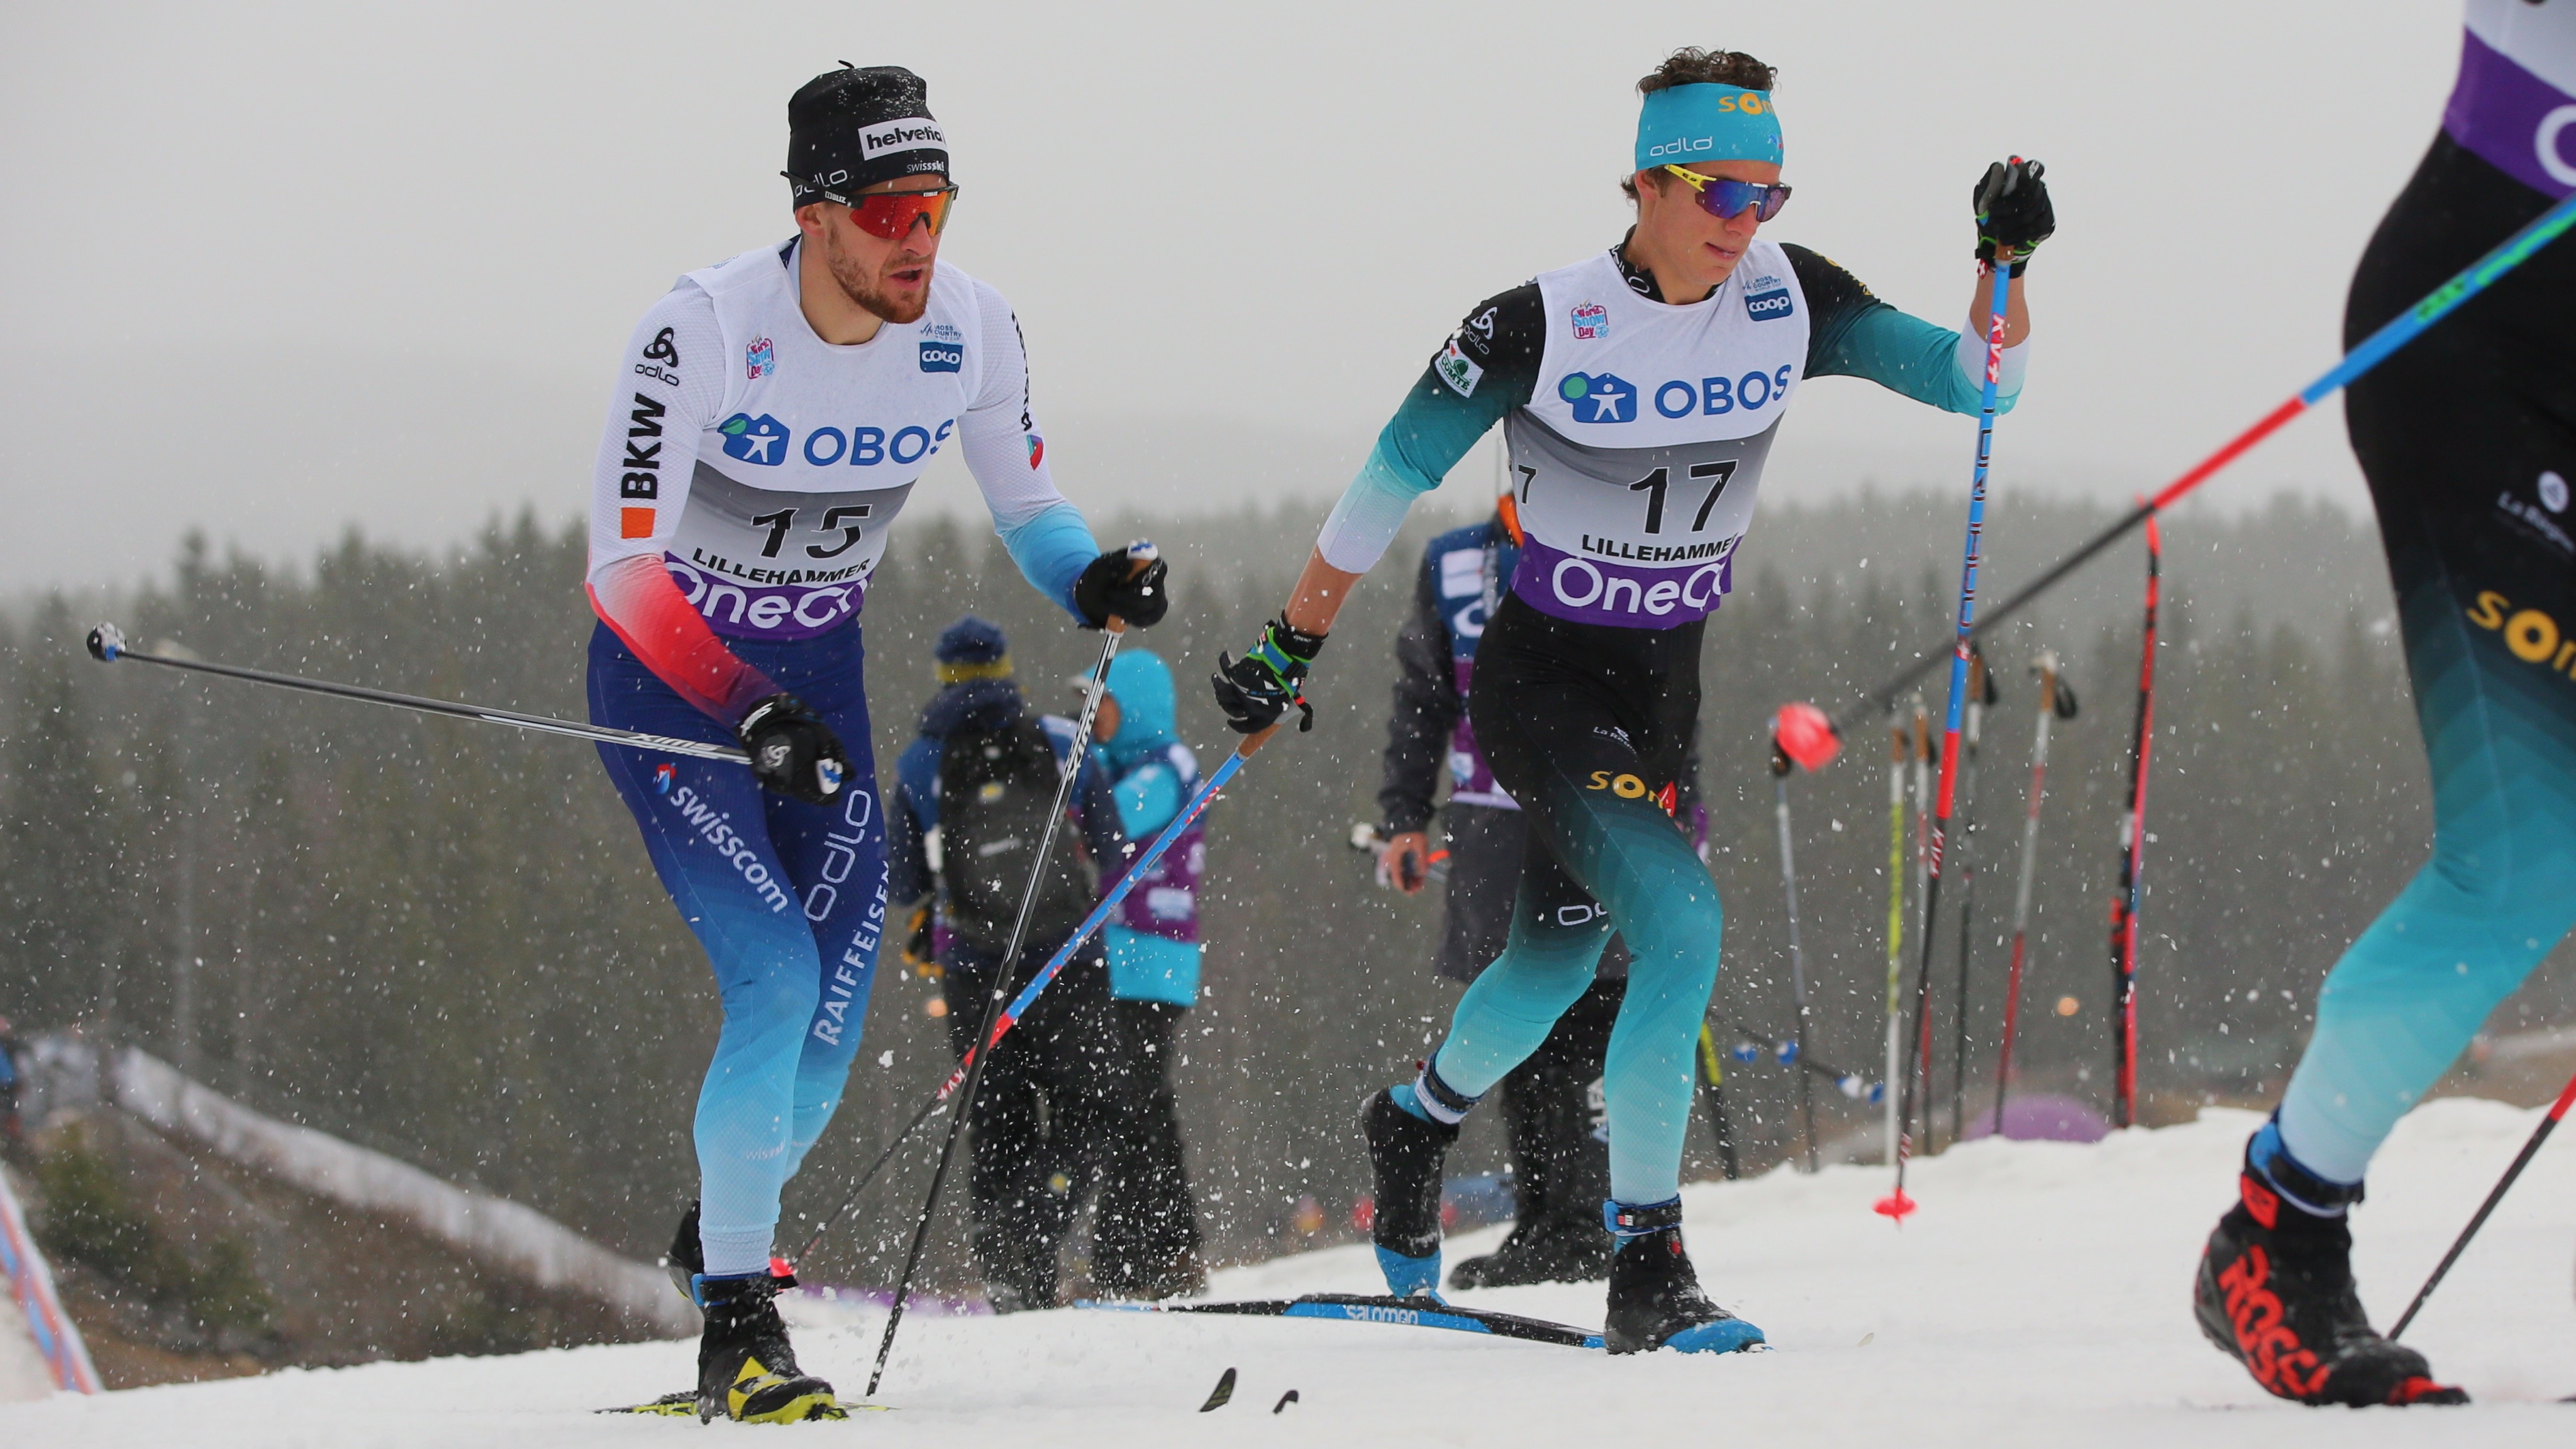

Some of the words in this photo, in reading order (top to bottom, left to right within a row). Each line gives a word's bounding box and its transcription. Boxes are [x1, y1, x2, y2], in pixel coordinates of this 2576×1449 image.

[865, 126, 942, 150] helvetia
[1650, 136, 1713, 157] odlo
[1573, 314, 1604, 327] Snow
[1748, 296, 1790, 313] coop
[1578, 327, 1594, 337] Day
[635, 364, 680, 386] odlo
[1655, 364, 1791, 419] OBOS
[621, 392, 666, 499] BKW
[804, 419, 954, 466] OBOS
[1629, 459, 1739, 535] 17
[751, 504, 873, 559] 15
[692, 547, 870, 585] LILLEHAMMER
[670, 786, 789, 913] swisscom
[803, 789, 872, 921] odlo
[813, 860, 889, 1046] RAIFFEISEN
[1346, 1304, 1419, 1325] salomon
